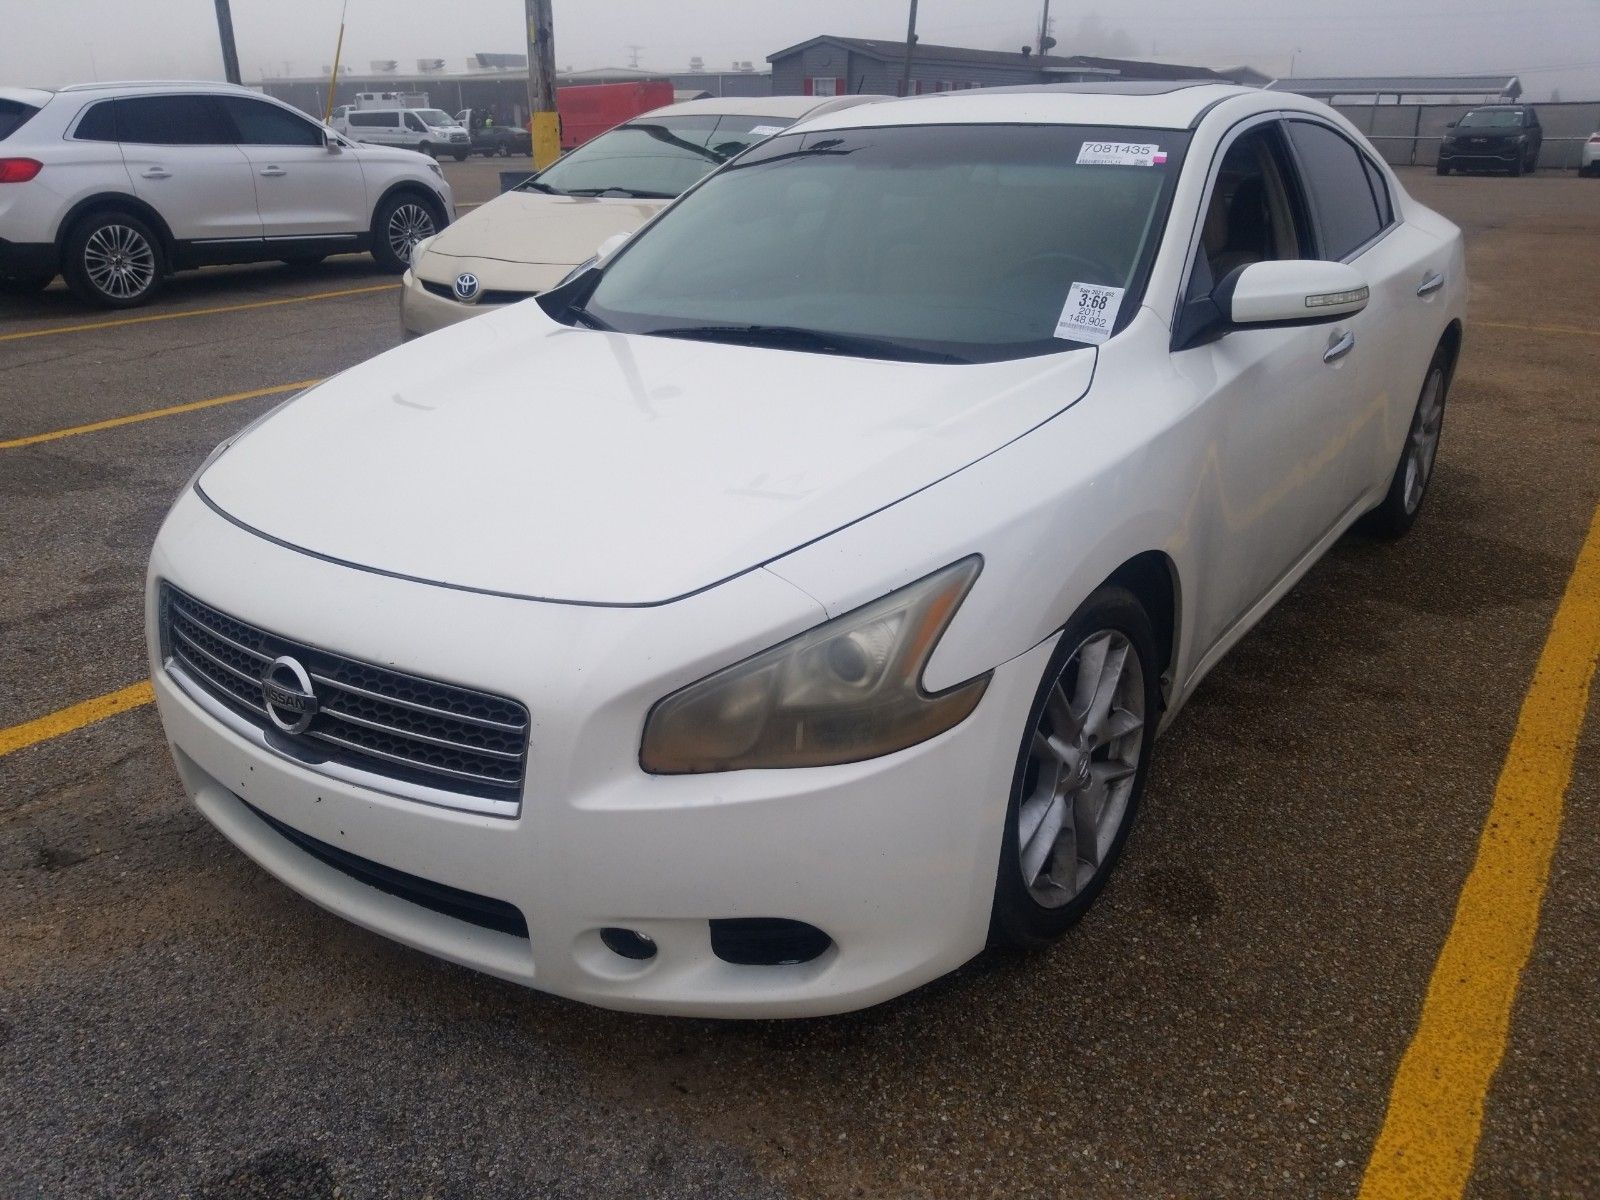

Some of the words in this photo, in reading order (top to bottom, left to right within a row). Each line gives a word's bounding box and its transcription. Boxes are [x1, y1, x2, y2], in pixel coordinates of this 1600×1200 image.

[1085, 143, 1150, 154] 7081435
[1079, 294, 1108, 310] 3:68
[1079, 307, 1102, 317] 2011
[1070, 314, 1107, 328] 148,902
[265, 686, 305, 710] NISSAN
